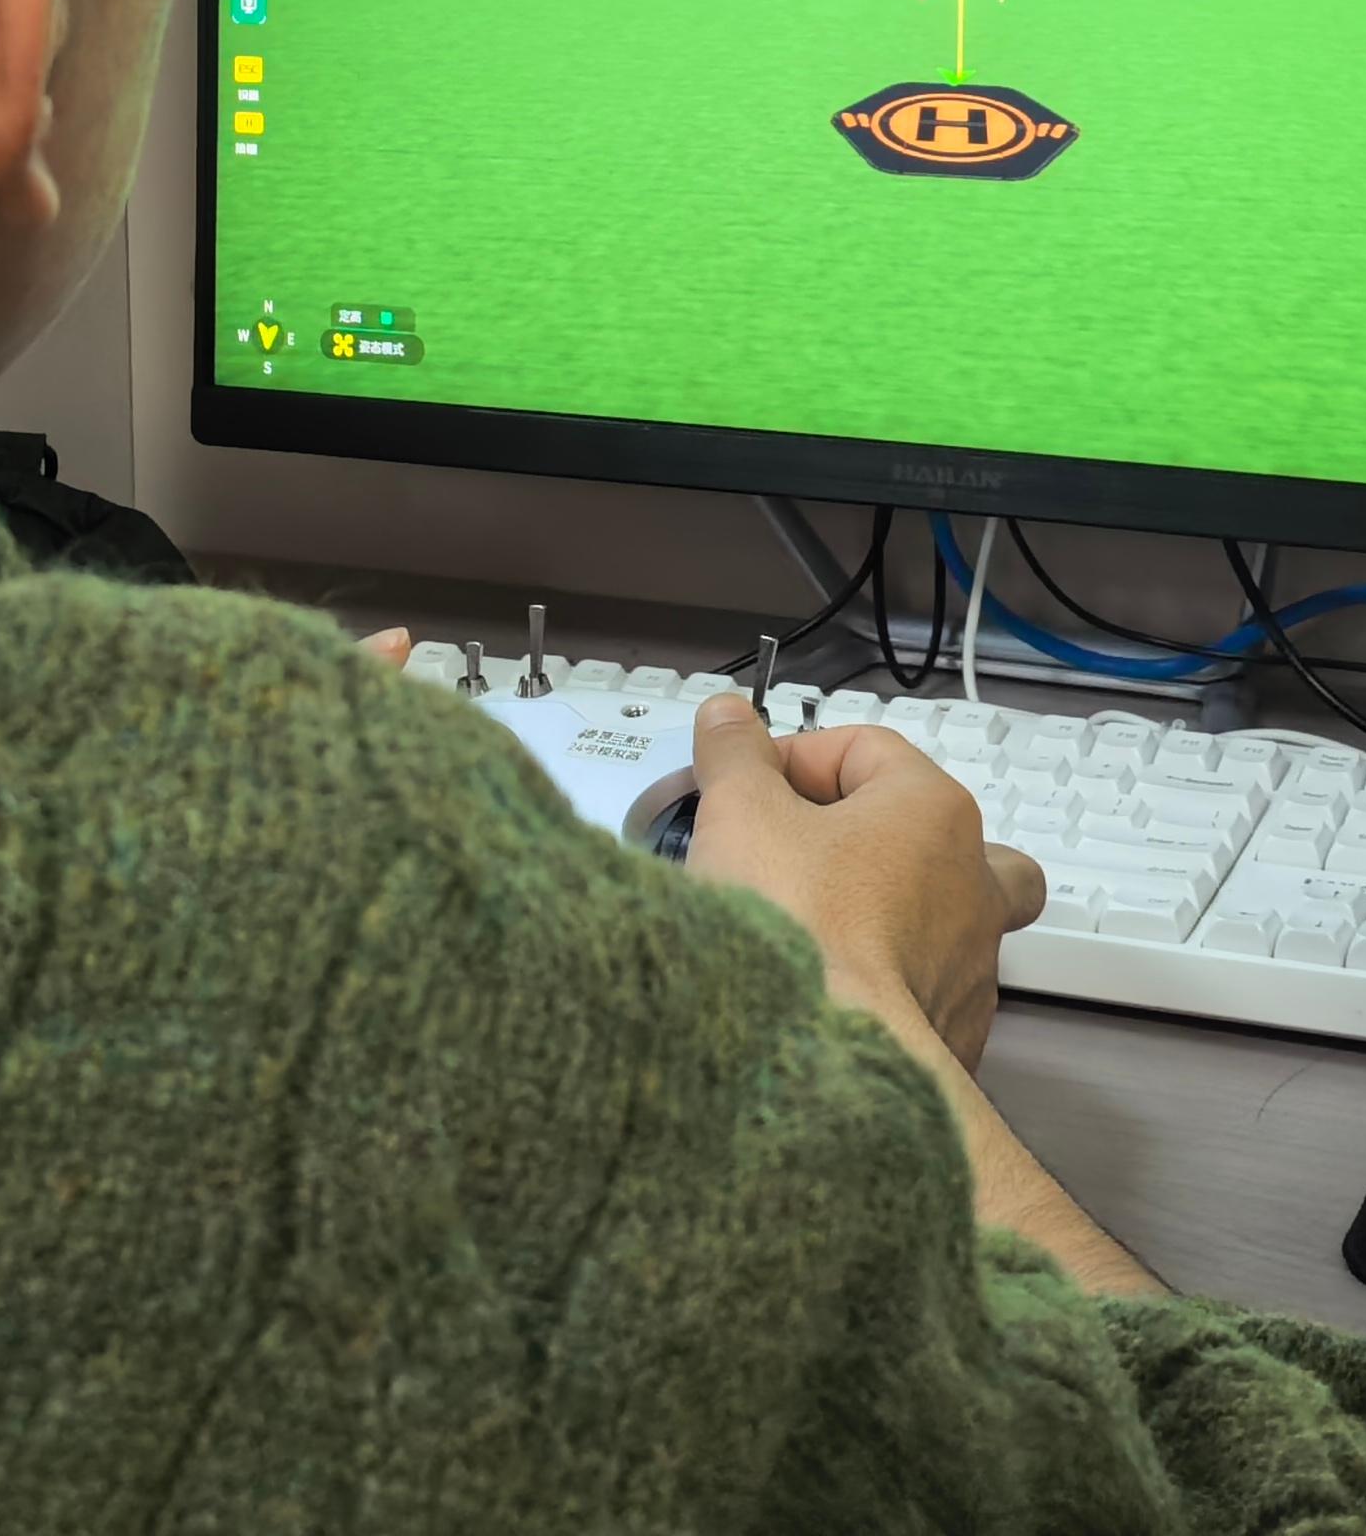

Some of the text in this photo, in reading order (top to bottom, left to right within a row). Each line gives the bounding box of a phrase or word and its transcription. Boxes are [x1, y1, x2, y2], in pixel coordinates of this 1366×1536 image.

[916, 106, 989, 145] H
[264, 300, 274, 313] N
[237, 329, 296, 346] W E
[263, 362, 272, 374] S
